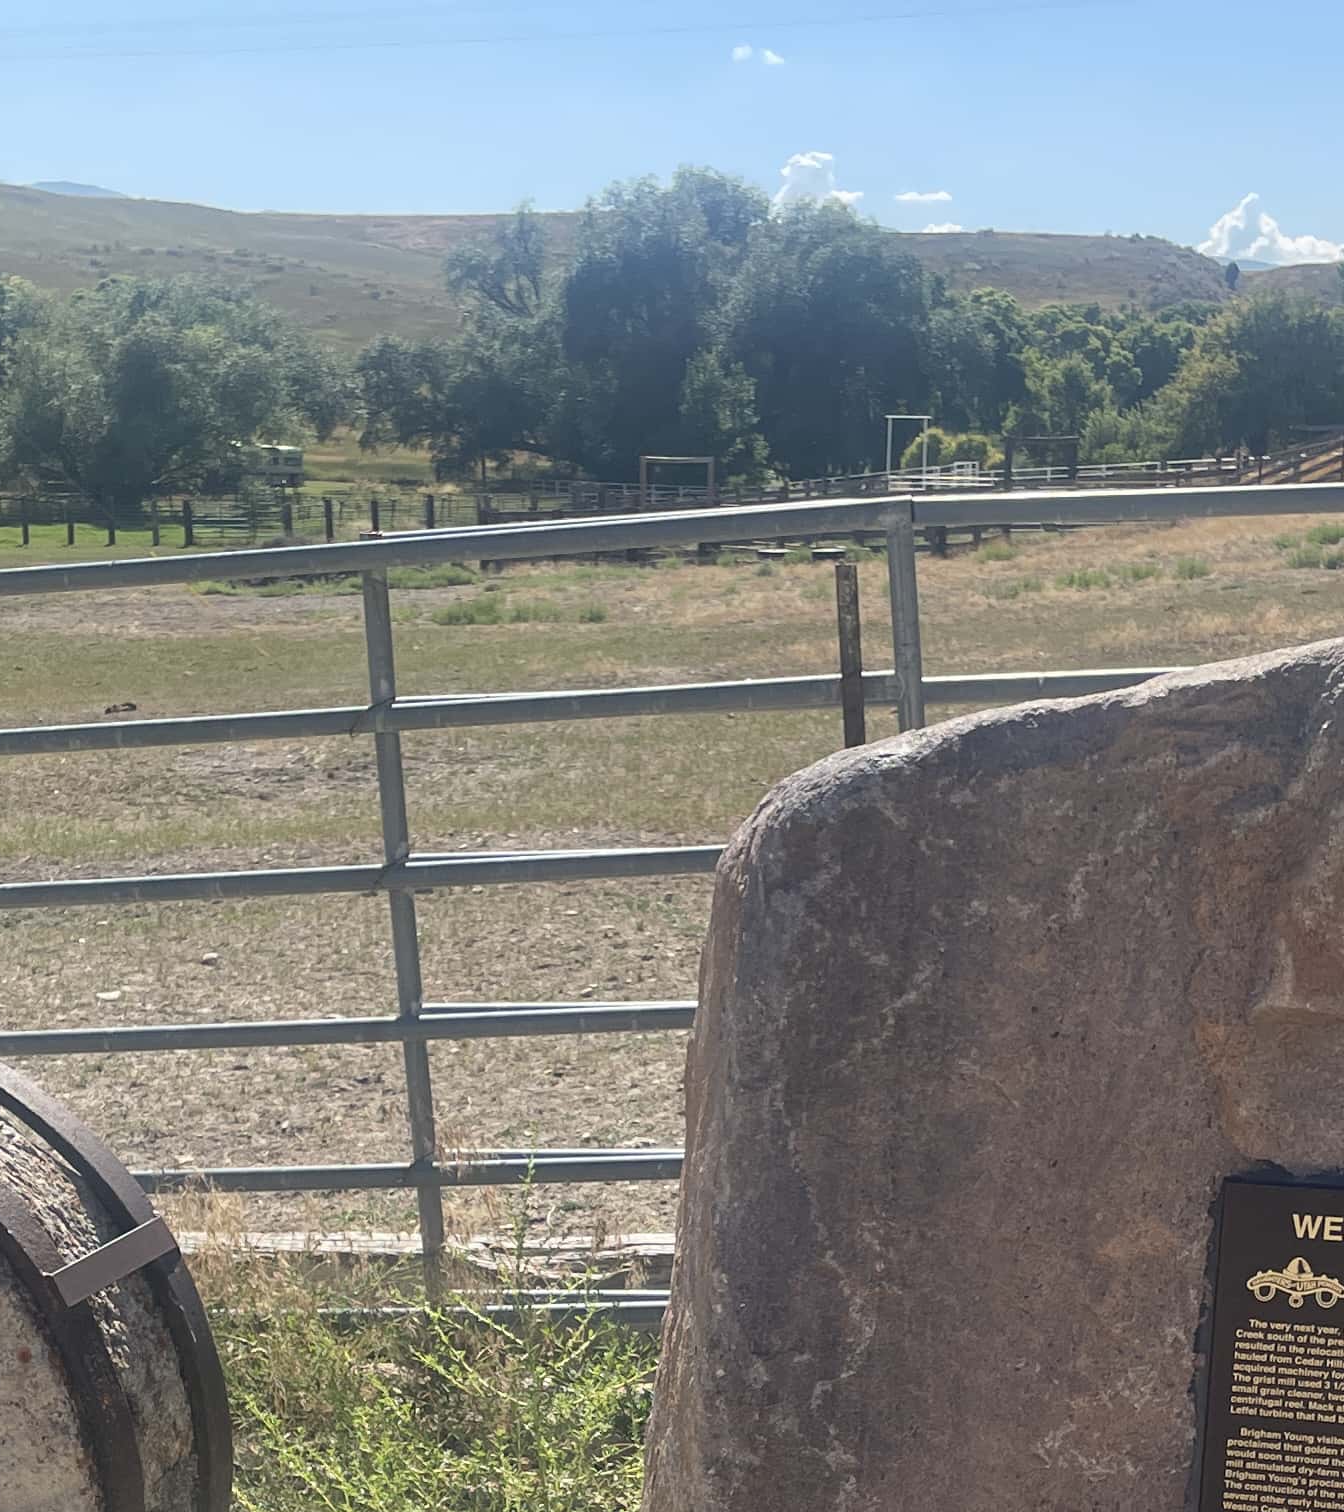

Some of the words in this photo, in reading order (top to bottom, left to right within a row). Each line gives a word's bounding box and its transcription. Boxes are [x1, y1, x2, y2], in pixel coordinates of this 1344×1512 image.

[1248, 1319, 1268, 1328] The
[1269, 1322, 1291, 1332] very
[1293, 1322, 1315, 1332] next
[1235, 1329, 1264, 1339] Creek
[1266, 1331, 1294, 1342] south
[1296, 1334, 1307, 1343] of
[1309, 1335, 1326, 1345] the
[1233, 1362, 1276, 1375] acquired
[1277, 1365, 1329, 1380] machinery
[1230, 1405, 1257, 1415] Leffel
[1259, 1408, 1294, 1419] turbine
[1295, 1411, 1315, 1421] that
[1316, 1413, 1336, 1422] had
[1240, 1427, 1281, 1440] Brigham
[1283, 1431, 1314, 1443] Young
[1226, 1447, 1256, 1458] would
[1258, 1452, 1282, 1461] soon
[1284, 1453, 1329, 1465] surround
[1226, 1458, 1243, 1468] mill
[1245, 1460, 1296, 1473] stimulated
[1297, 1465, 1339, 1479] dry-farm
